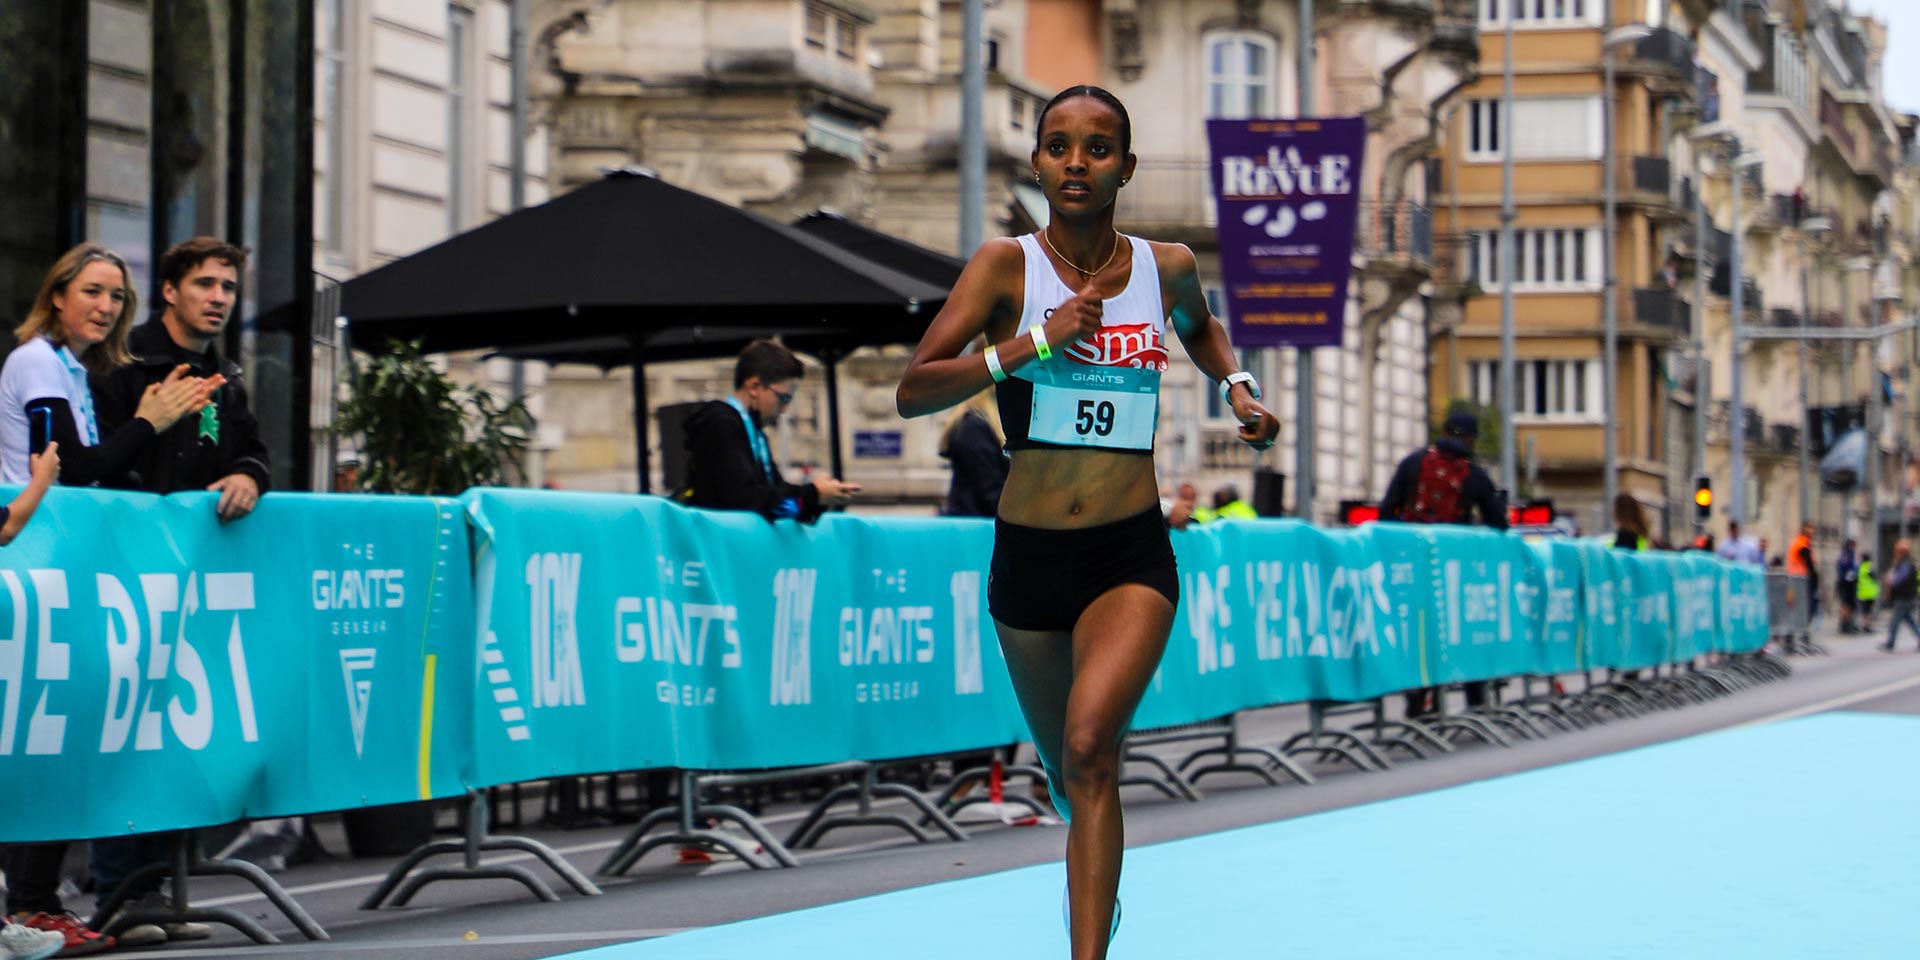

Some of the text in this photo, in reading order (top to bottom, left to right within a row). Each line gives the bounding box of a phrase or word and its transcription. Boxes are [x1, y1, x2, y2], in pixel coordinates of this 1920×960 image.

[1221, 154, 1350, 196] REVUE
[1072, 373, 1125, 384] GIANTS
[1075, 399, 1115, 436] 59
[343, 543, 374, 560] THE
[312, 569, 404, 610] GIANTS
[872, 568, 906, 593] THE
[525, 552, 586, 708] 10K
[615, 596, 742, 669] GINTS
[770, 568, 817, 706] 10K
[838, 605, 934, 667] GIANTS
[96, 569, 259, 753] BEST
